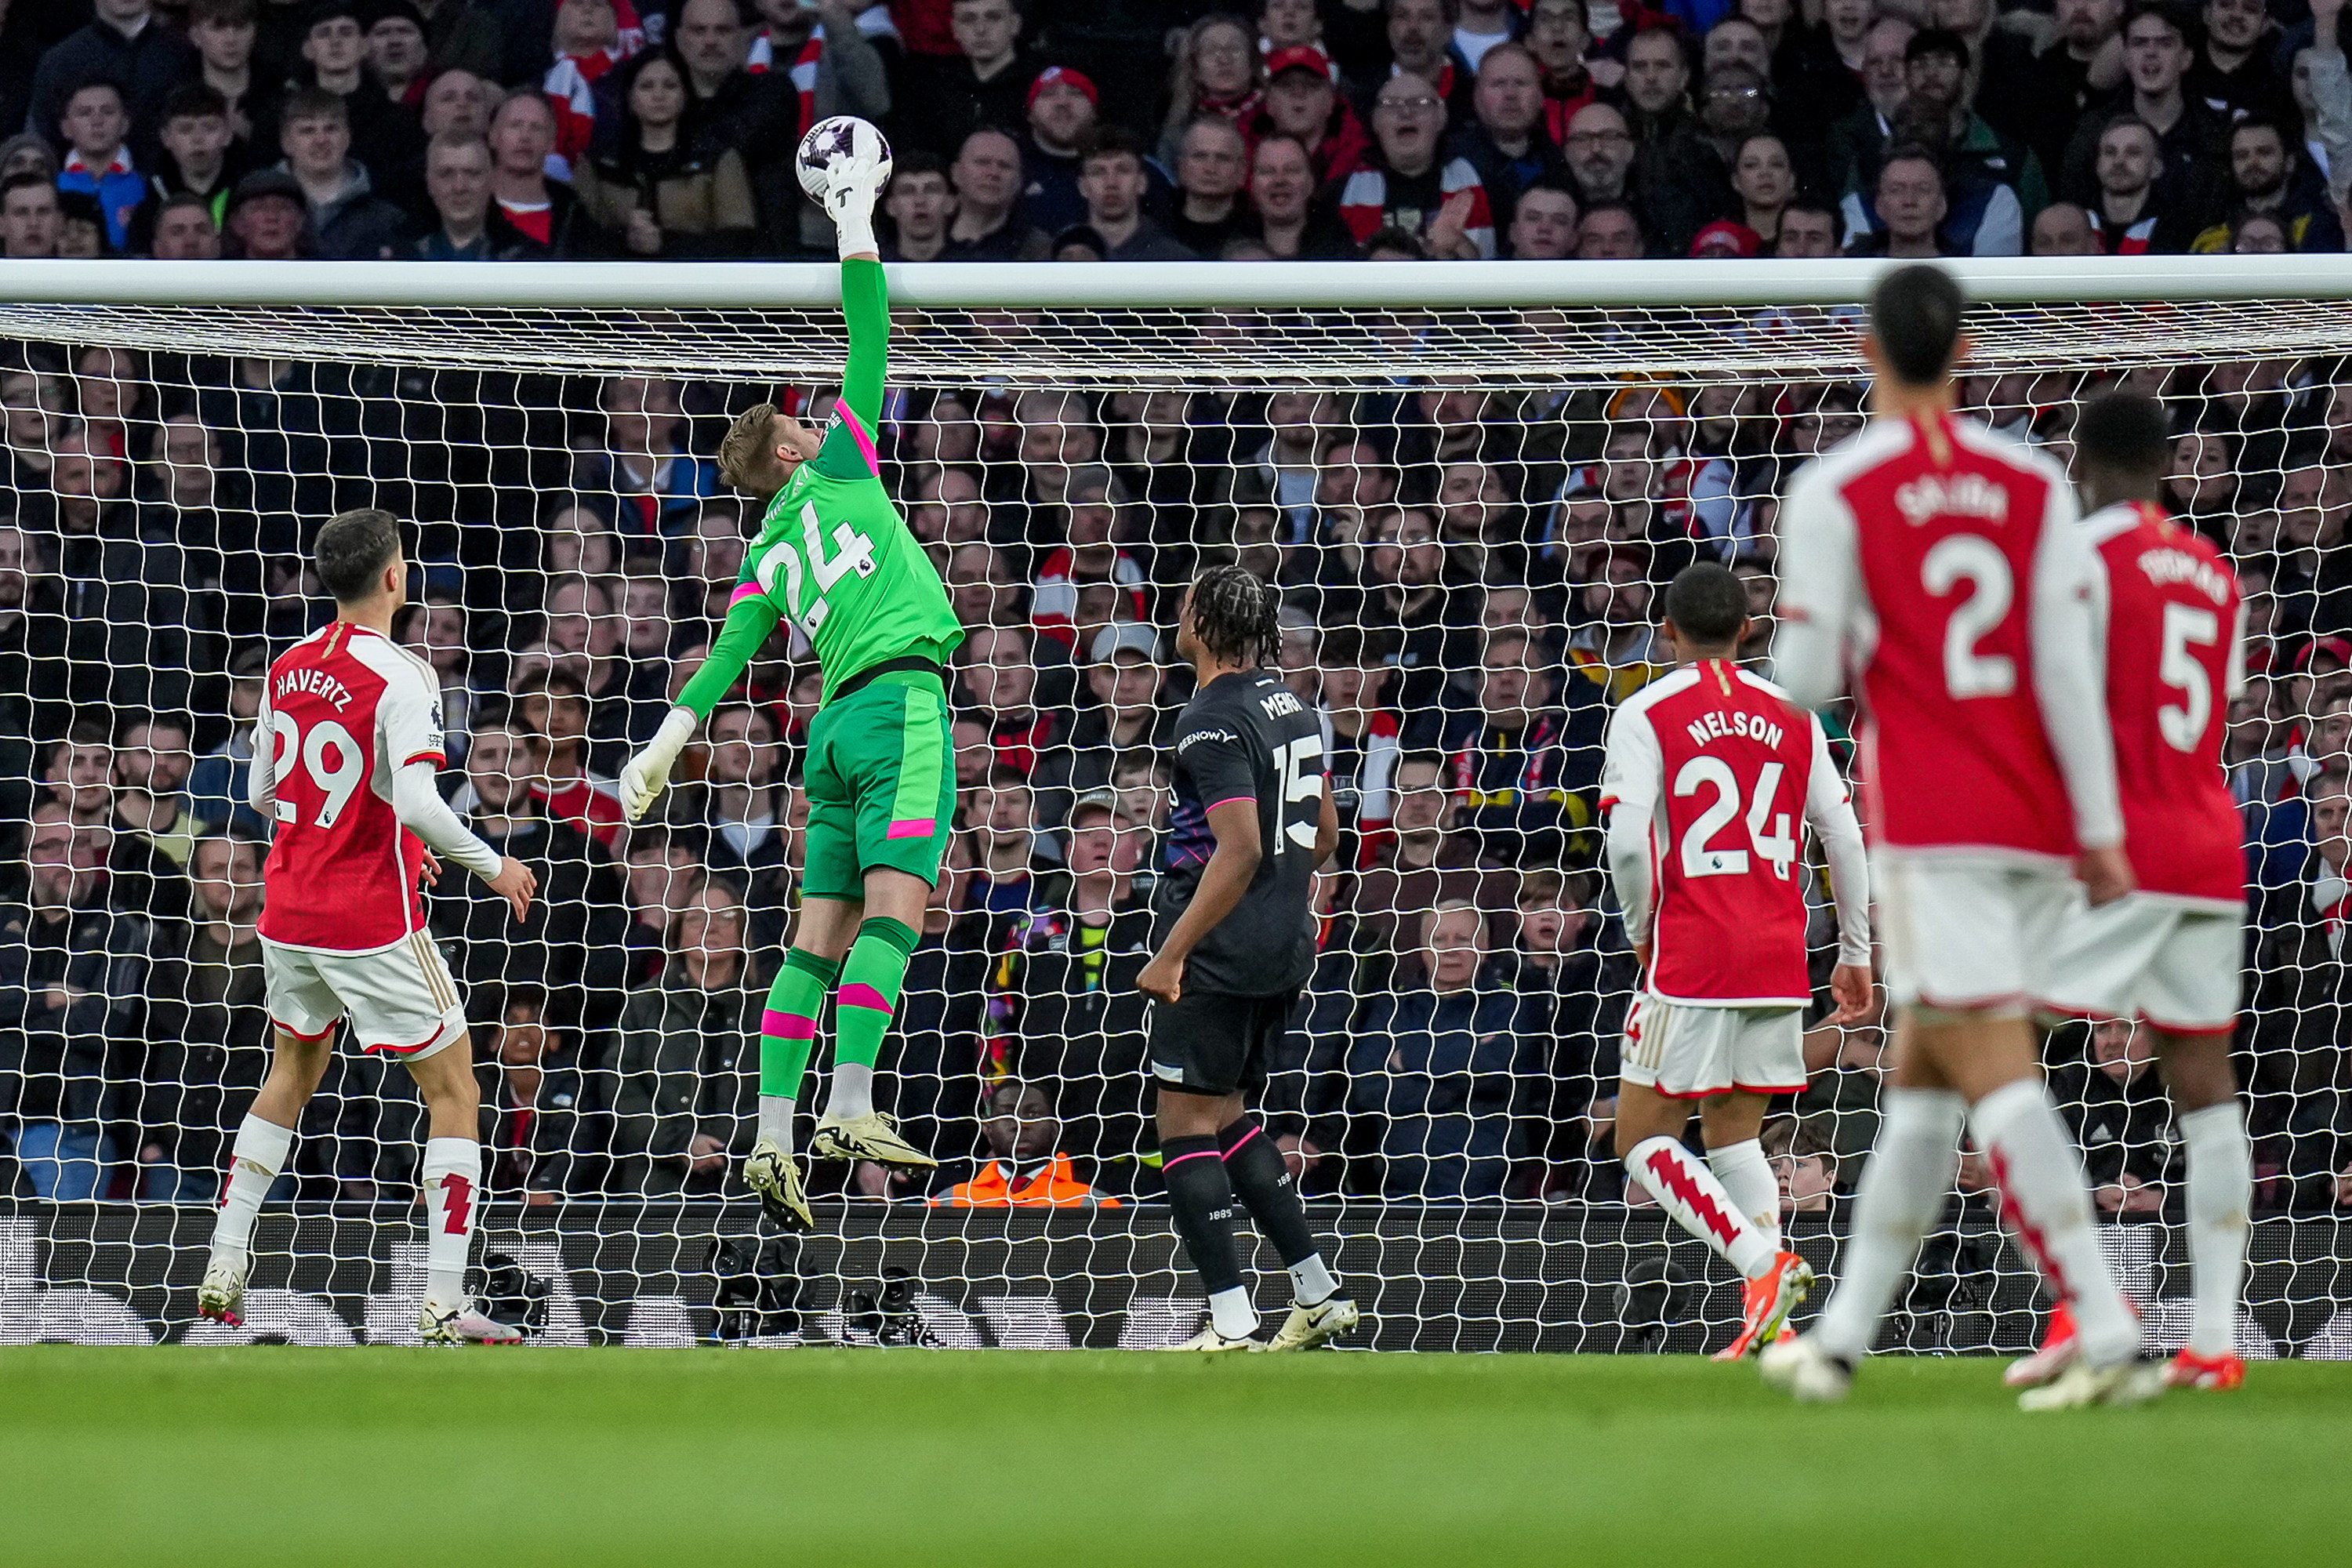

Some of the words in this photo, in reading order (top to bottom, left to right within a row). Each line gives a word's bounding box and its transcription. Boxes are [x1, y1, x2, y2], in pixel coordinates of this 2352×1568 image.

[756, 499, 877, 644] 24
[1922, 533, 2017, 700] 2
[276, 668, 353, 714] HAVERTZ
[1686, 710, 1784, 750] NELSON
[2158, 600, 2218, 753] 5
[274, 710, 365, 829] 29
[1272, 734, 1323, 855] 15
[1673, 755, 1797, 882] 24
